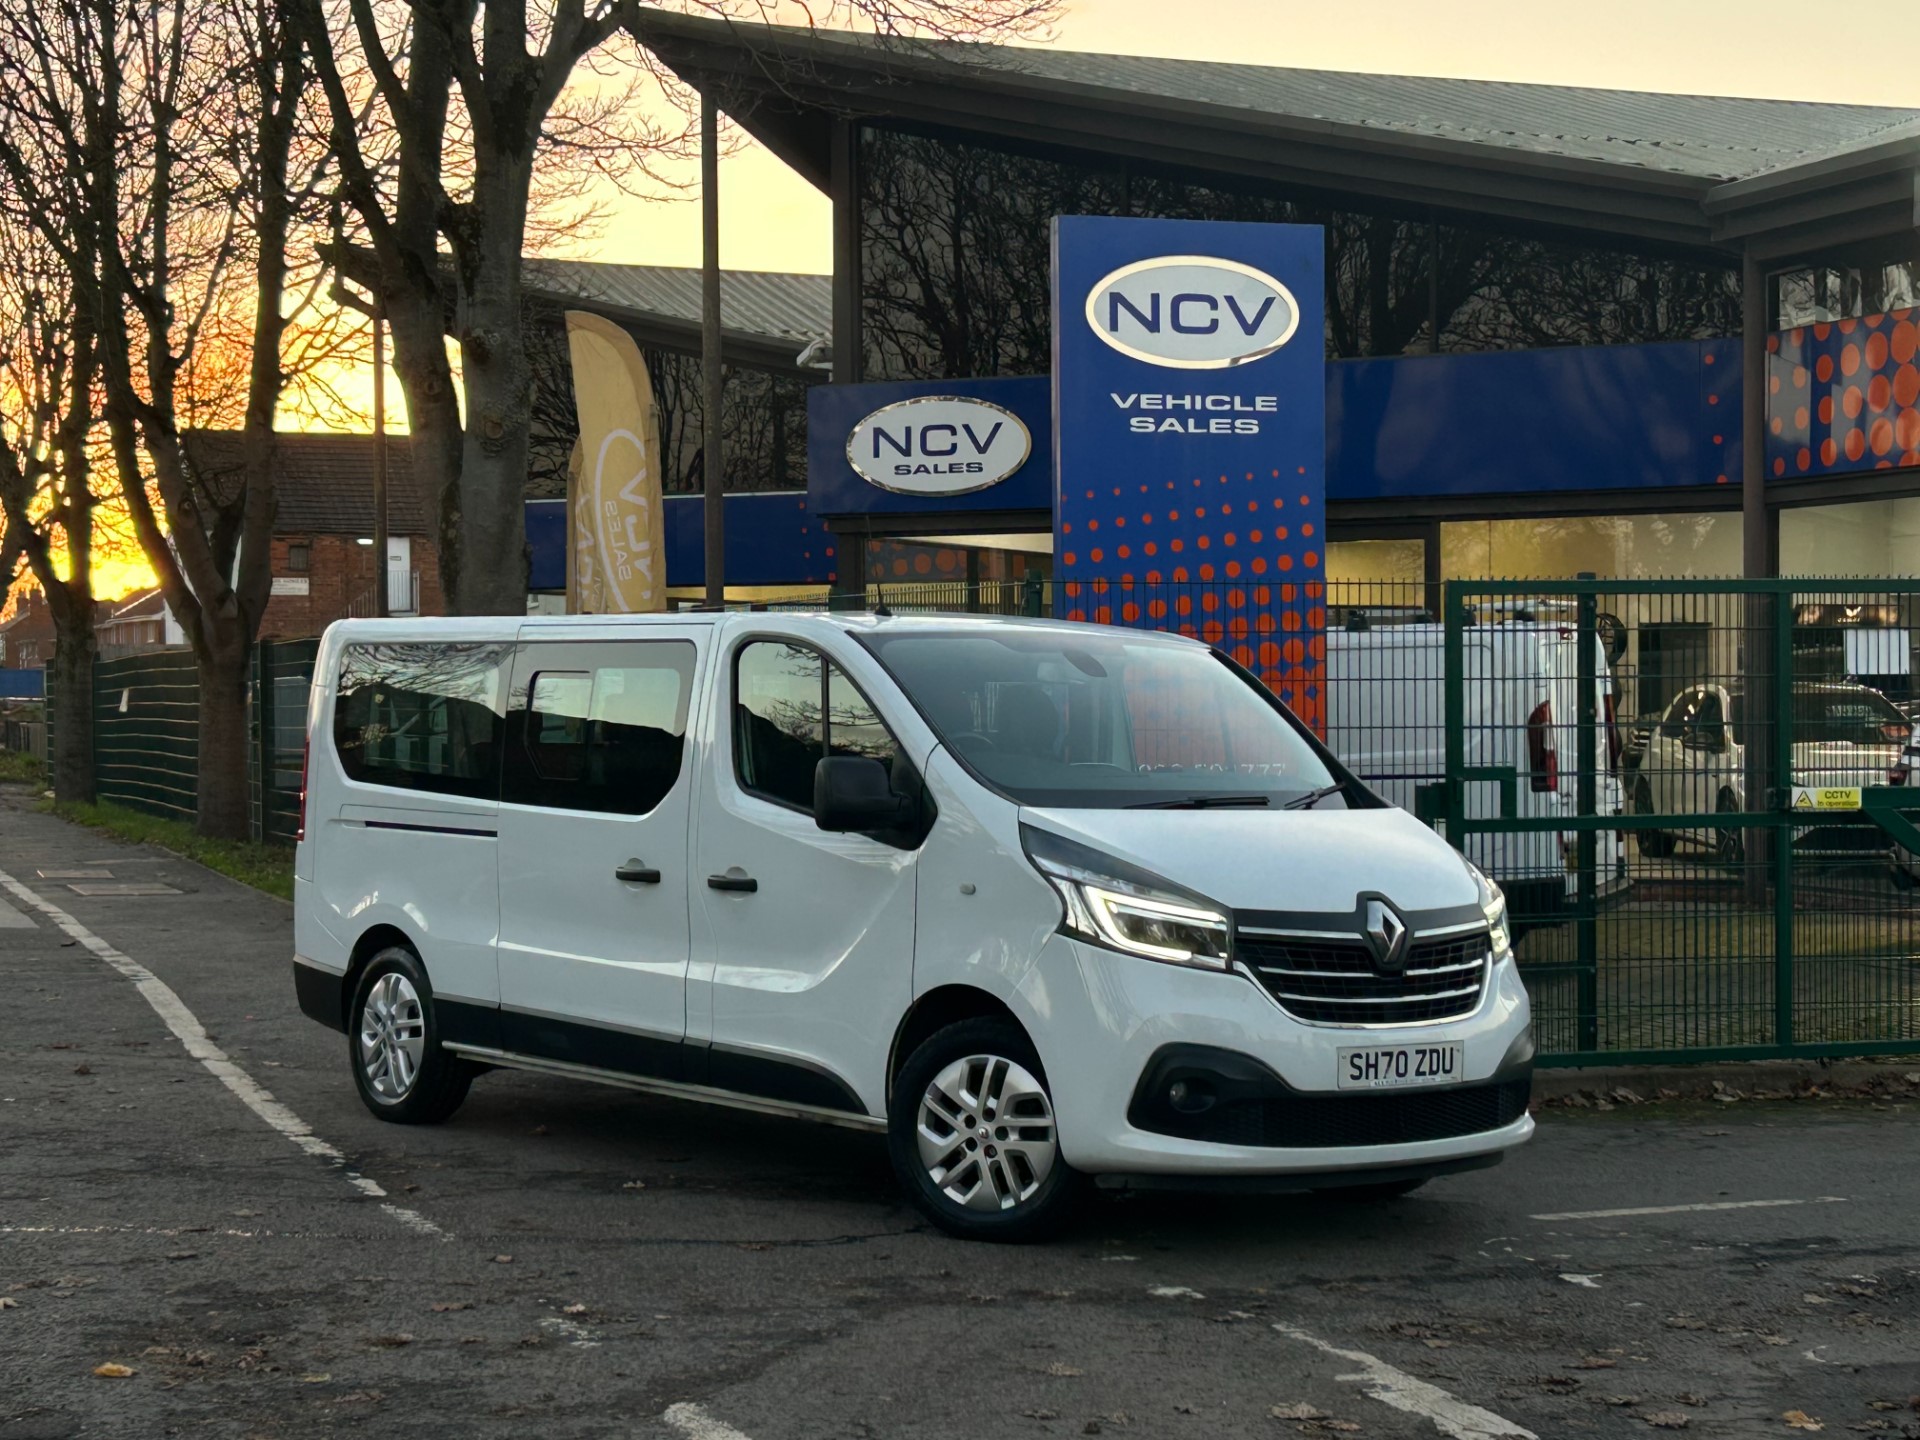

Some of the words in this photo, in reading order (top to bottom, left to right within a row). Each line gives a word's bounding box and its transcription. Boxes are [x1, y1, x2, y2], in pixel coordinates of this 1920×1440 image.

[1109, 292, 1276, 336] NCV
[1110, 393, 1277, 412] VEHICLE
[1130, 417, 1260, 434] SALES
[873, 422, 1003, 458] NCV
[894, 462, 983, 475] SALES
[1824, 790, 1851, 799] CCTV
[1350, 1050, 1408, 1080] SH70
[1415, 1047, 1453, 1076] ZDU
